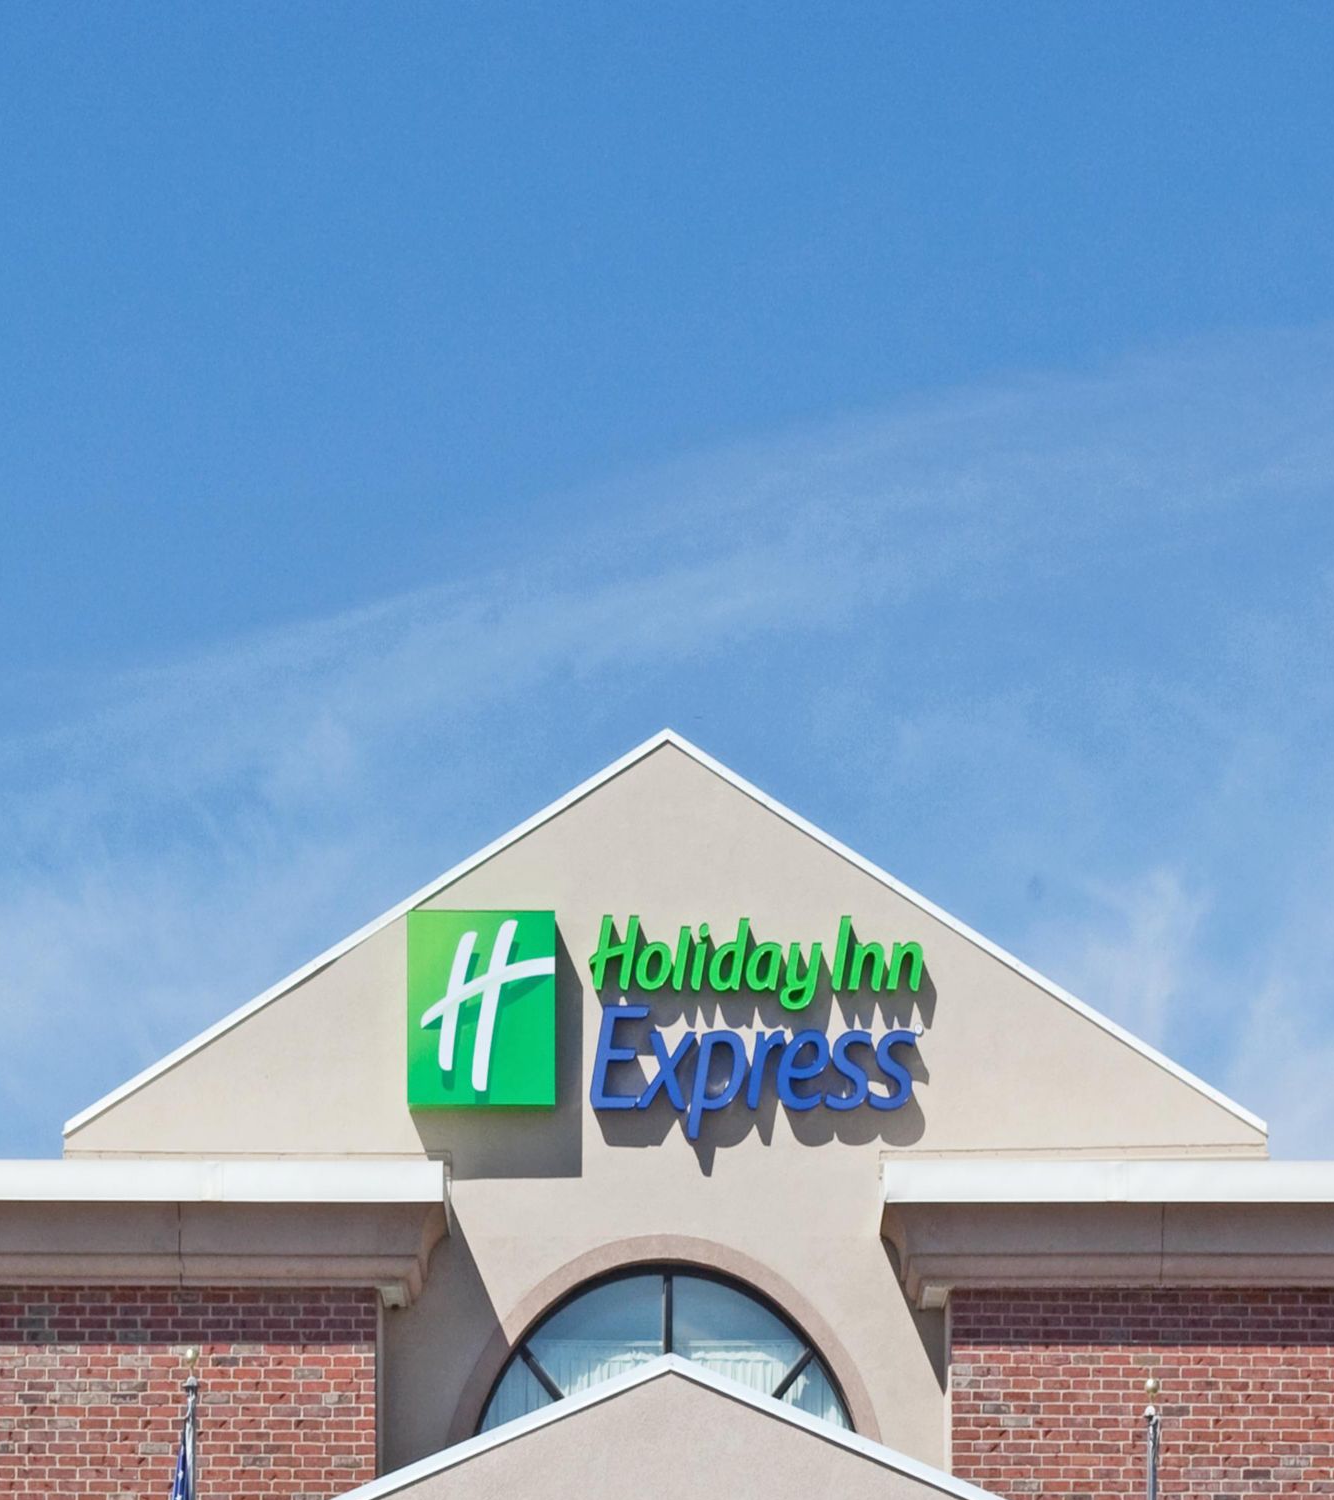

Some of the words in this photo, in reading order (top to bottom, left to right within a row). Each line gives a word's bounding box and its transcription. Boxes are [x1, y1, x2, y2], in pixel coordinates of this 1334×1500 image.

[420, 919, 555, 1092] H
[589, 914, 822, 1010] Holiday
[831, 915, 923, 992] Inn
[590, 1005, 917, 1140] Express
